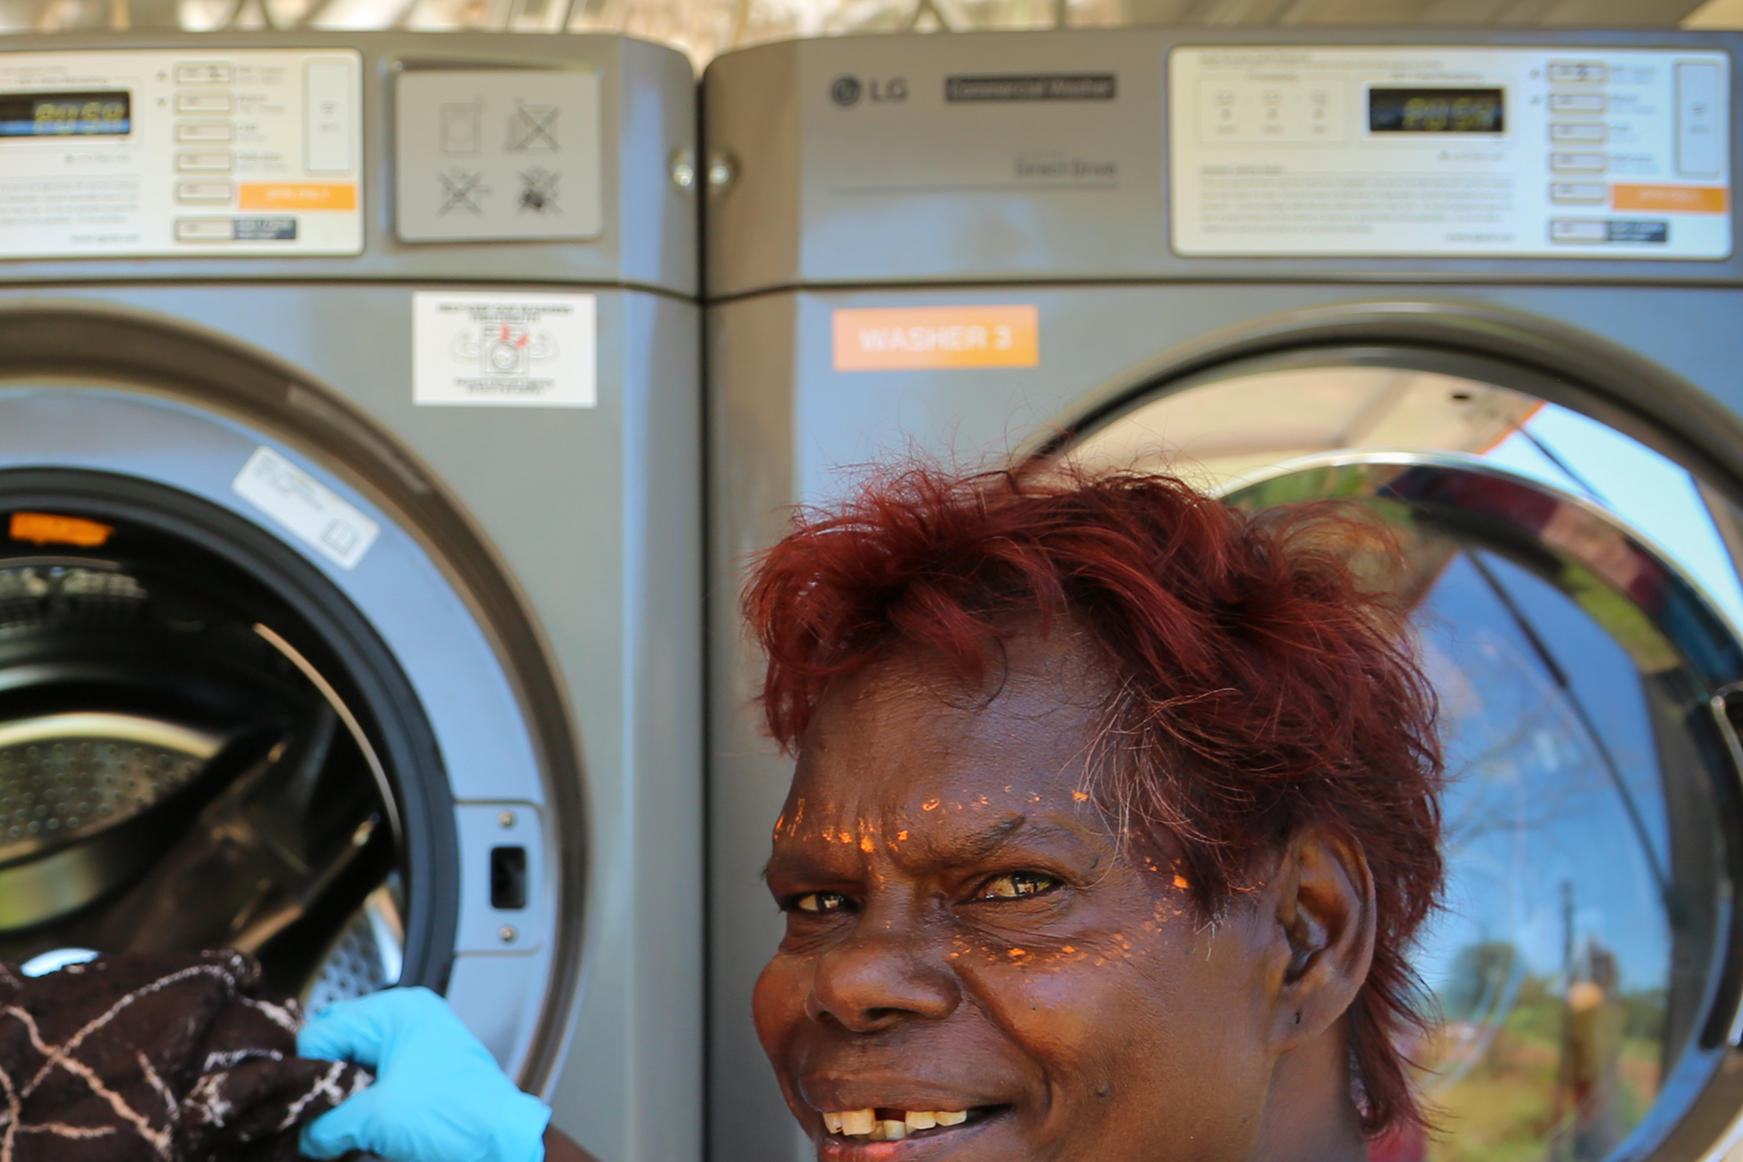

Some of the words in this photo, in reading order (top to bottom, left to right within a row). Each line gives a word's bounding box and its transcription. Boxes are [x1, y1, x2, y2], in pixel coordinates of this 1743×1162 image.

[868, 76, 911, 103] LG
[858, 325, 989, 351] WASHER
[993, 323, 1012, 350] 3
